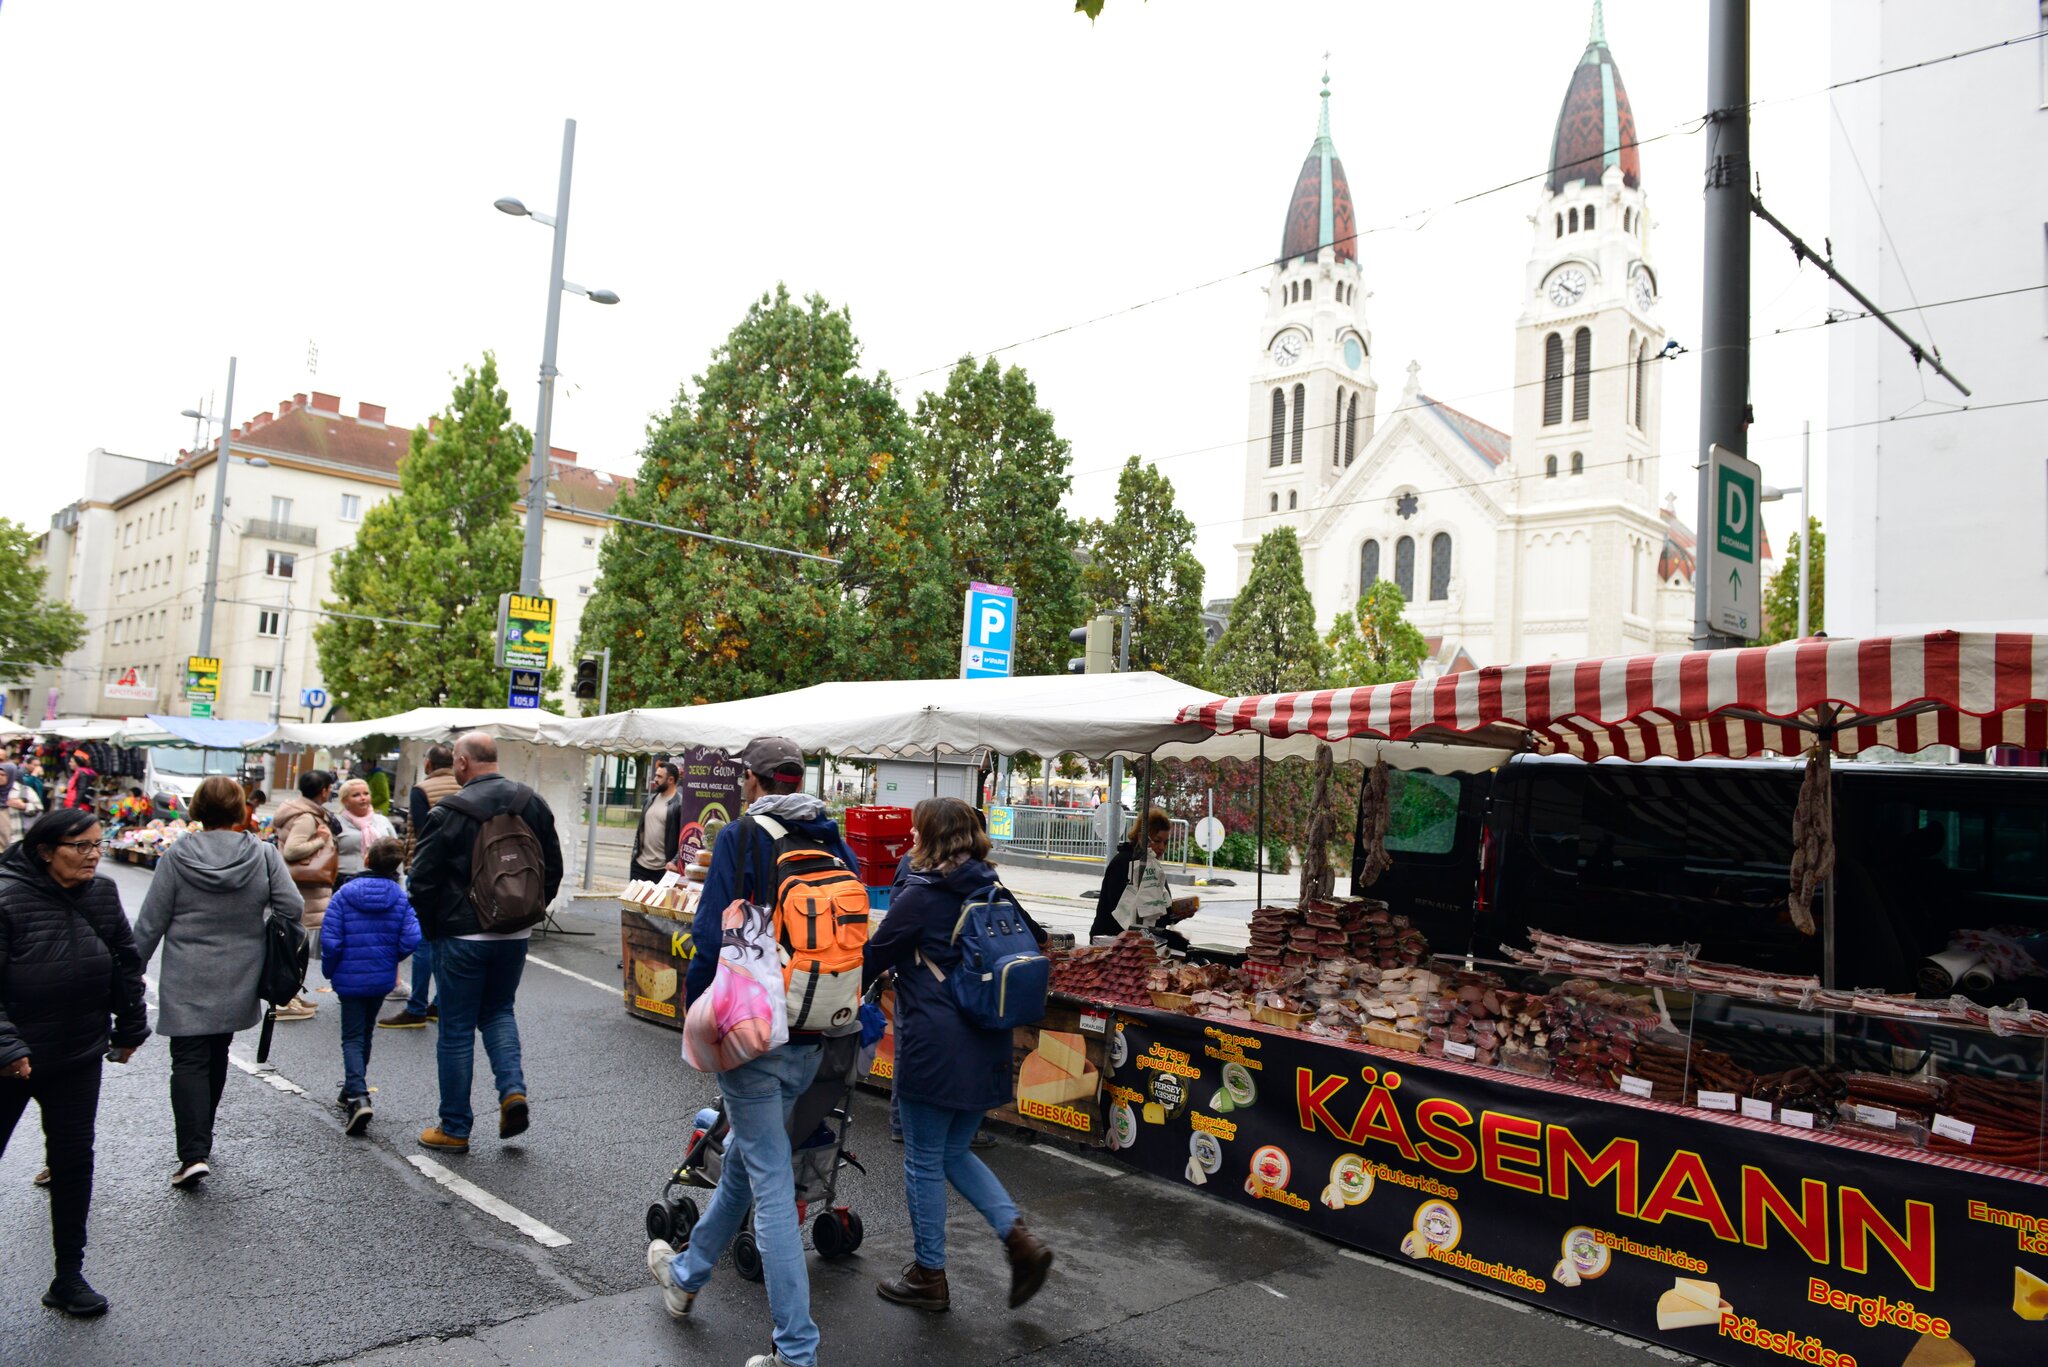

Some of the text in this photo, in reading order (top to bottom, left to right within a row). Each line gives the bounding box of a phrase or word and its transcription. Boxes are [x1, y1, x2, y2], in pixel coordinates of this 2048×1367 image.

[1725, 481, 1747, 534] D
[1721, 535, 1750, 553] DEICHMANN
[511, 594, 550, 613] BILLA
[980, 607, 1005, 644] P
[310, 691, 323, 707] U
[689, 764, 736, 776] JERSEY GOUDA
[635, 995, 676, 1017] EMMENTALER
[1149, 1042, 1190, 1063] Jersey
[1233, 1035, 1261, 1049] pesto
[1136, 1054, 1200, 1079] goudakäse
[1155, 1081, 1181, 1094] JERSEY
[1020, 1099, 1090, 1131] LIEBESKÄSE
[1191, 1111, 1237, 1132] Ziegenkäse
[1202, 1124, 1235, 1141] Monate
[1297, 1066, 1935, 1291] KÄSEMANN
[1361, 1158, 1458, 1200] Kräuterkäse
[1262, 1185, 1310, 1211] Chilikäse
[1593, 1228, 1708, 1274] Bärlauchkäse
[1427, 1242, 1546, 1293] Knoblauchkäse
[1808, 1277, 1950, 1339] Bergkäse
[1718, 1312, 1858, 1367] Rässkäse
